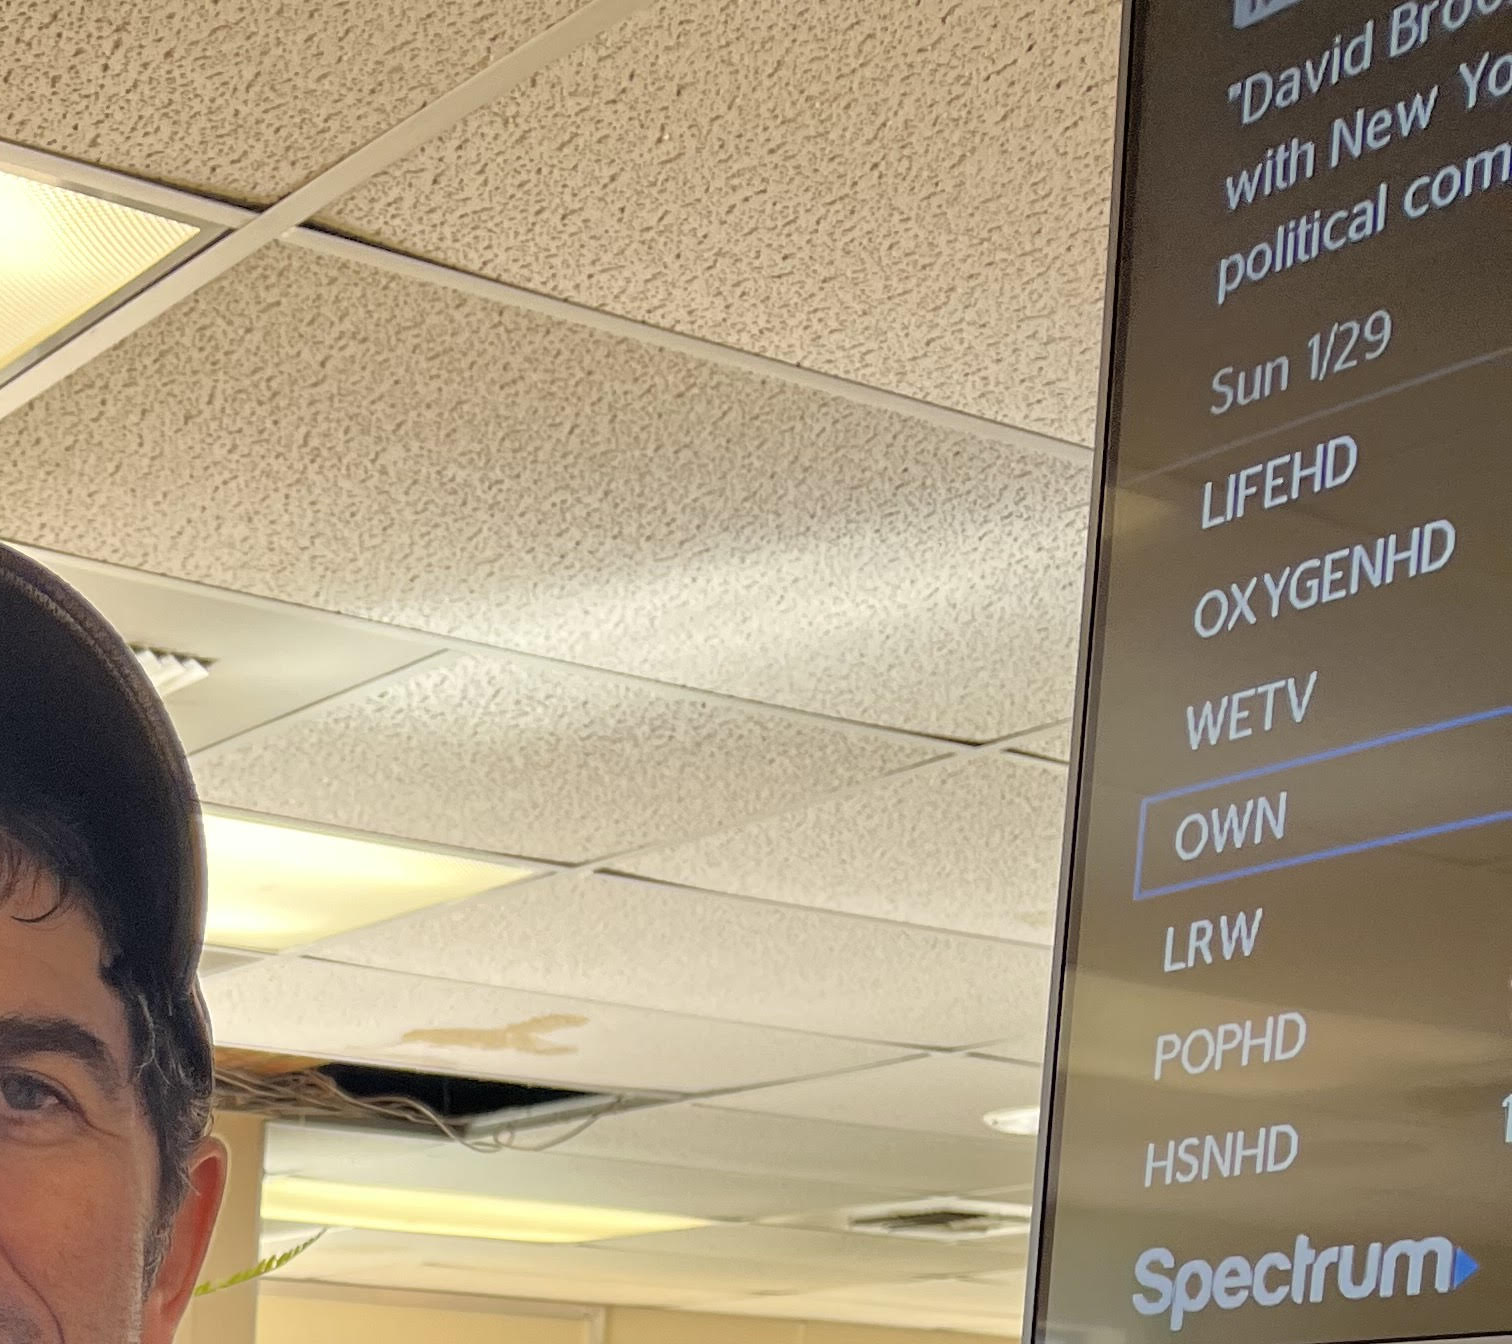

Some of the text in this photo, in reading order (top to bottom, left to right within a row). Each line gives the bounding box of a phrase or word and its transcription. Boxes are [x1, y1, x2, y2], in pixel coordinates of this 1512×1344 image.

[1228, 18, 1374, 125] "David
[1225, 136, 1316, 211] with
[1330, 84, 1439, 168] New
[1217, 142, 1512, 306] political com
[1210, 309, 1393, 415] Sun 1/29
[1200, 434, 1359, 530] LIFEHD
[1193, 518, 1456, 639] OXYGENHD
[1185, 670, 1319, 750] WETV
[1174, 791, 1288, 863] OWN
[1162, 907, 1265, 973] LRW
[1152, 1011, 1307, 1082] POPHD
[1143, 1123, 1299, 1187] HSNHD
[1132, 1233, 1454, 1331] Spectrum
